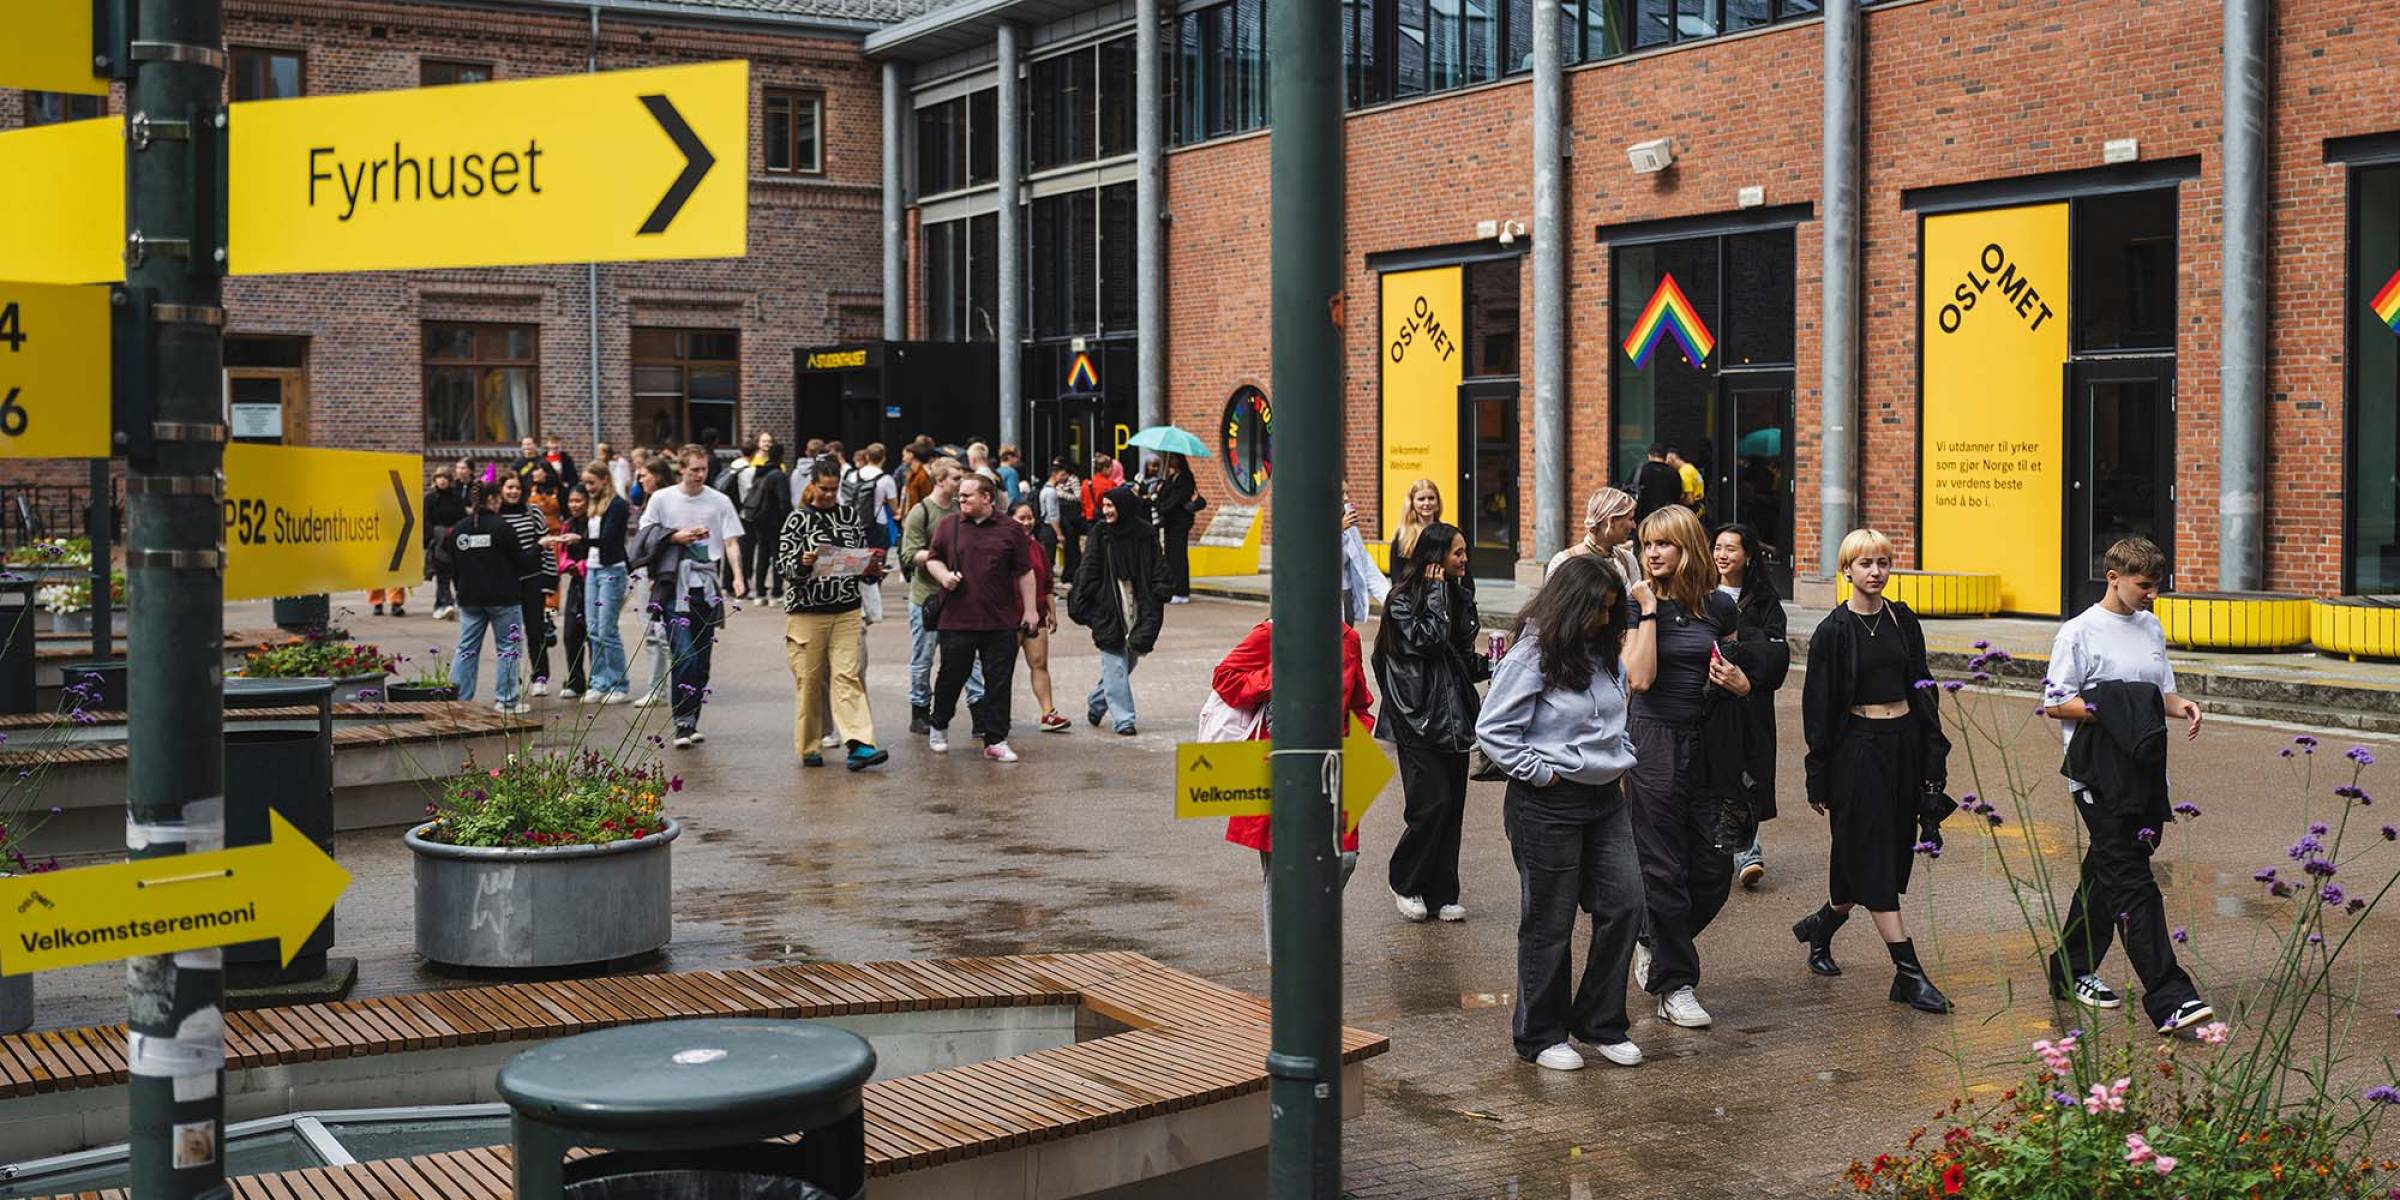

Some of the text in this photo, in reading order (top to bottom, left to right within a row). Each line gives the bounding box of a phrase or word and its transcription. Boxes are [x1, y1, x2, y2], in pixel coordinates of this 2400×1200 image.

[308, 139, 543, 222] Fyrhuset
[1938, 243, 2054, 334] OSLOMET
[1390, 295, 1456, 364] OSLOMET
[1935, 460, 2042, 473] som gjør Norge til et
[1936, 441, 2039, 455] Vi utdanner til yrker
[1935, 478, 2023, 490] av verdens beste
[1935, 494, 1957, 506] land
[1968, 495, 1981, 507] bo
[222, 499, 380, 545] P52 Studenthuset
[20, 901, 256, 953] Velkomstseremoni
